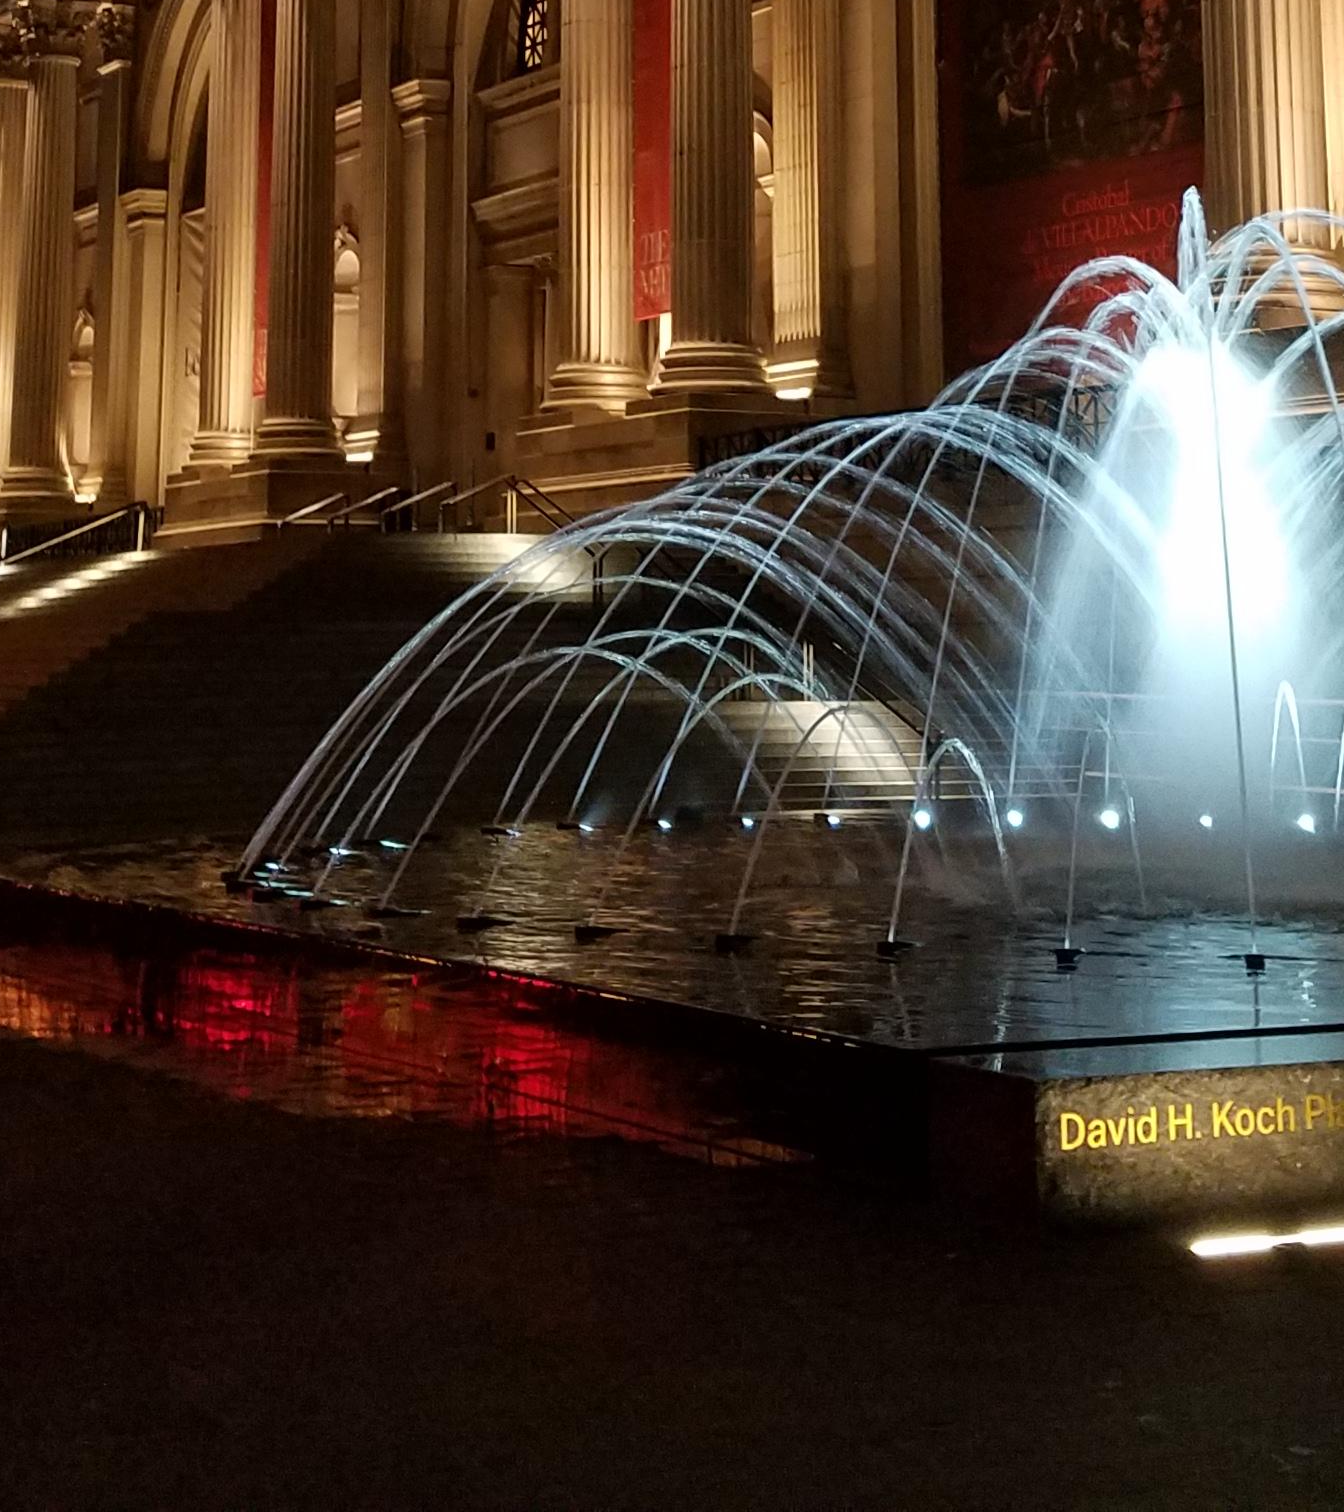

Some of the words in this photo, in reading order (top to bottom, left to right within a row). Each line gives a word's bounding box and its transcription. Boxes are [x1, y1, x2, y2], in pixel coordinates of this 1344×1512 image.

[1060, 1106, 1157, 1151] David
[1168, 1103, 1202, 1142] H.
[1212, 1097, 1296, 1138] Koch
